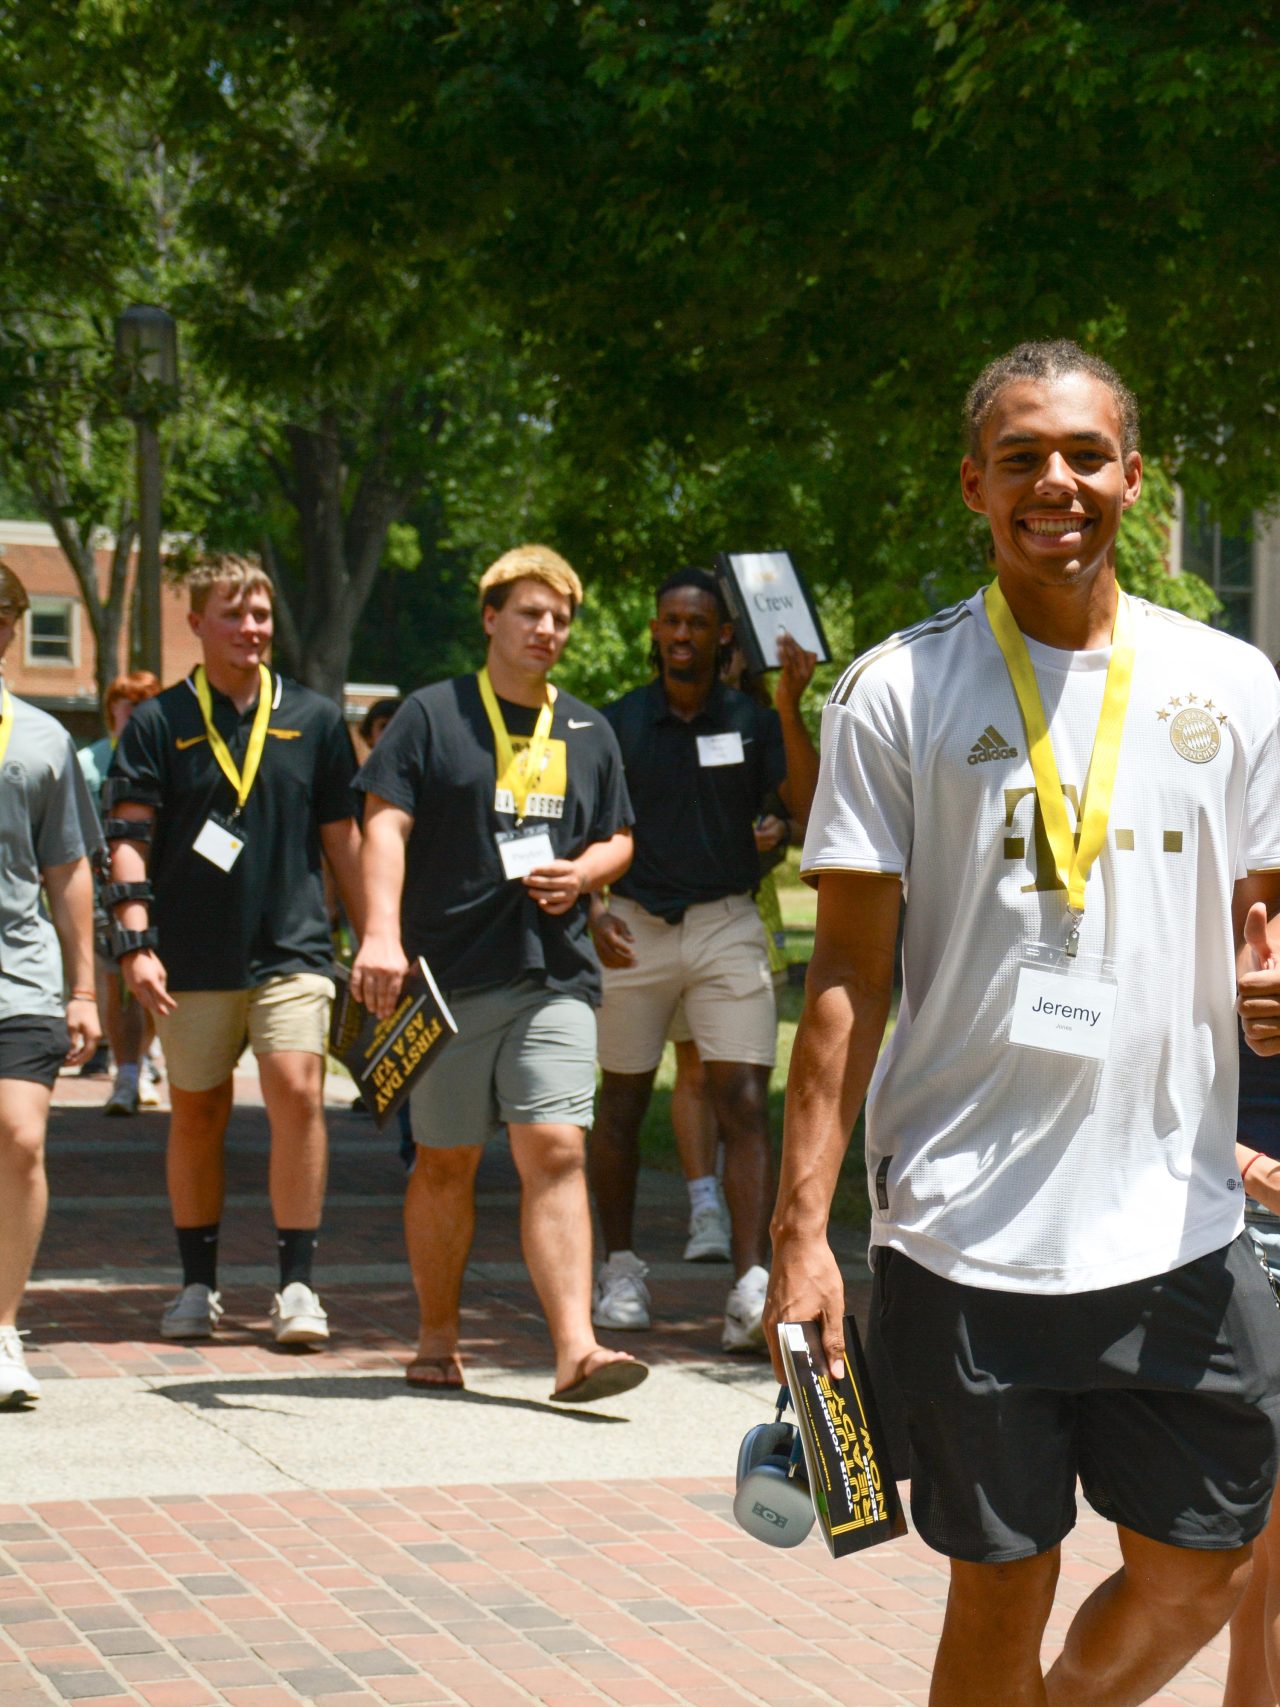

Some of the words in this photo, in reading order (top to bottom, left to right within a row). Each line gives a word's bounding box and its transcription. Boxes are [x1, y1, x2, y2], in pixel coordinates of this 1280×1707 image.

[753, 593, 794, 613] Crew
[967, 746, 1018, 765] adidas
[404, 1011, 425, 1043] AS
[1032, 997, 1101, 1027] Jeremy
[392, 1036, 405, 1057] A
[401, 1017, 443, 1077] FIRST
[375, 1069, 405, 1114] DAY
[804, 1341, 813, 1368] TO
[811, 1371, 843, 1458] JOURNEY
[818, 1375, 865, 1528] FUTURE
[831, 1387, 874, 1526] READY
[860, 1427, 888, 1521] NOW
[840, 1460, 854, 1514] YOUR
[863, 1455, 880, 1523] BEGINS
